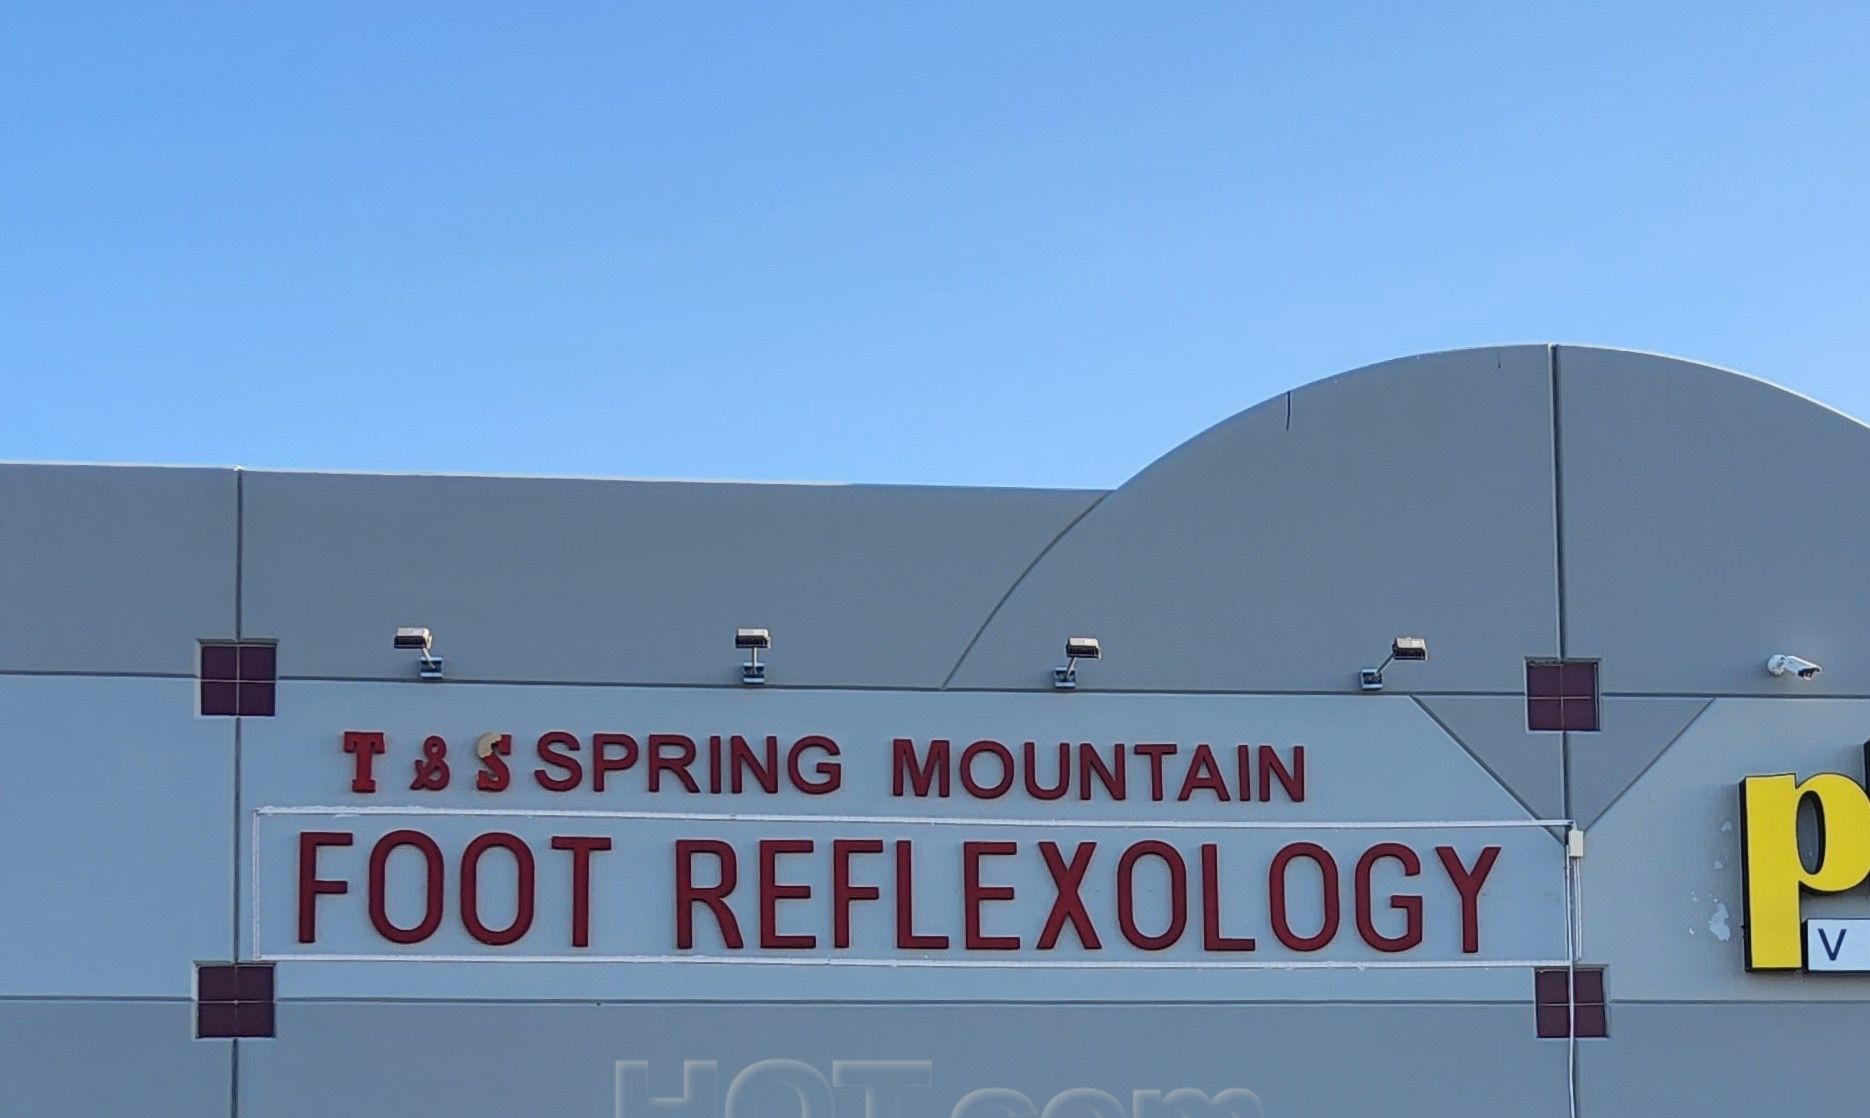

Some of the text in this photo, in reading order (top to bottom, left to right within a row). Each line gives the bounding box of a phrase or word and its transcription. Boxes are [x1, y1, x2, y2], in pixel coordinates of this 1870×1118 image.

[342, 731, 386, 794] T
[410, 735, 452, 792] &
[533, 731, 843, 795] SPRING
[891, 738, 1305, 803] MOUNTAIN
[297, 829, 1502, 953] FOOT REFLEXOLOGY
